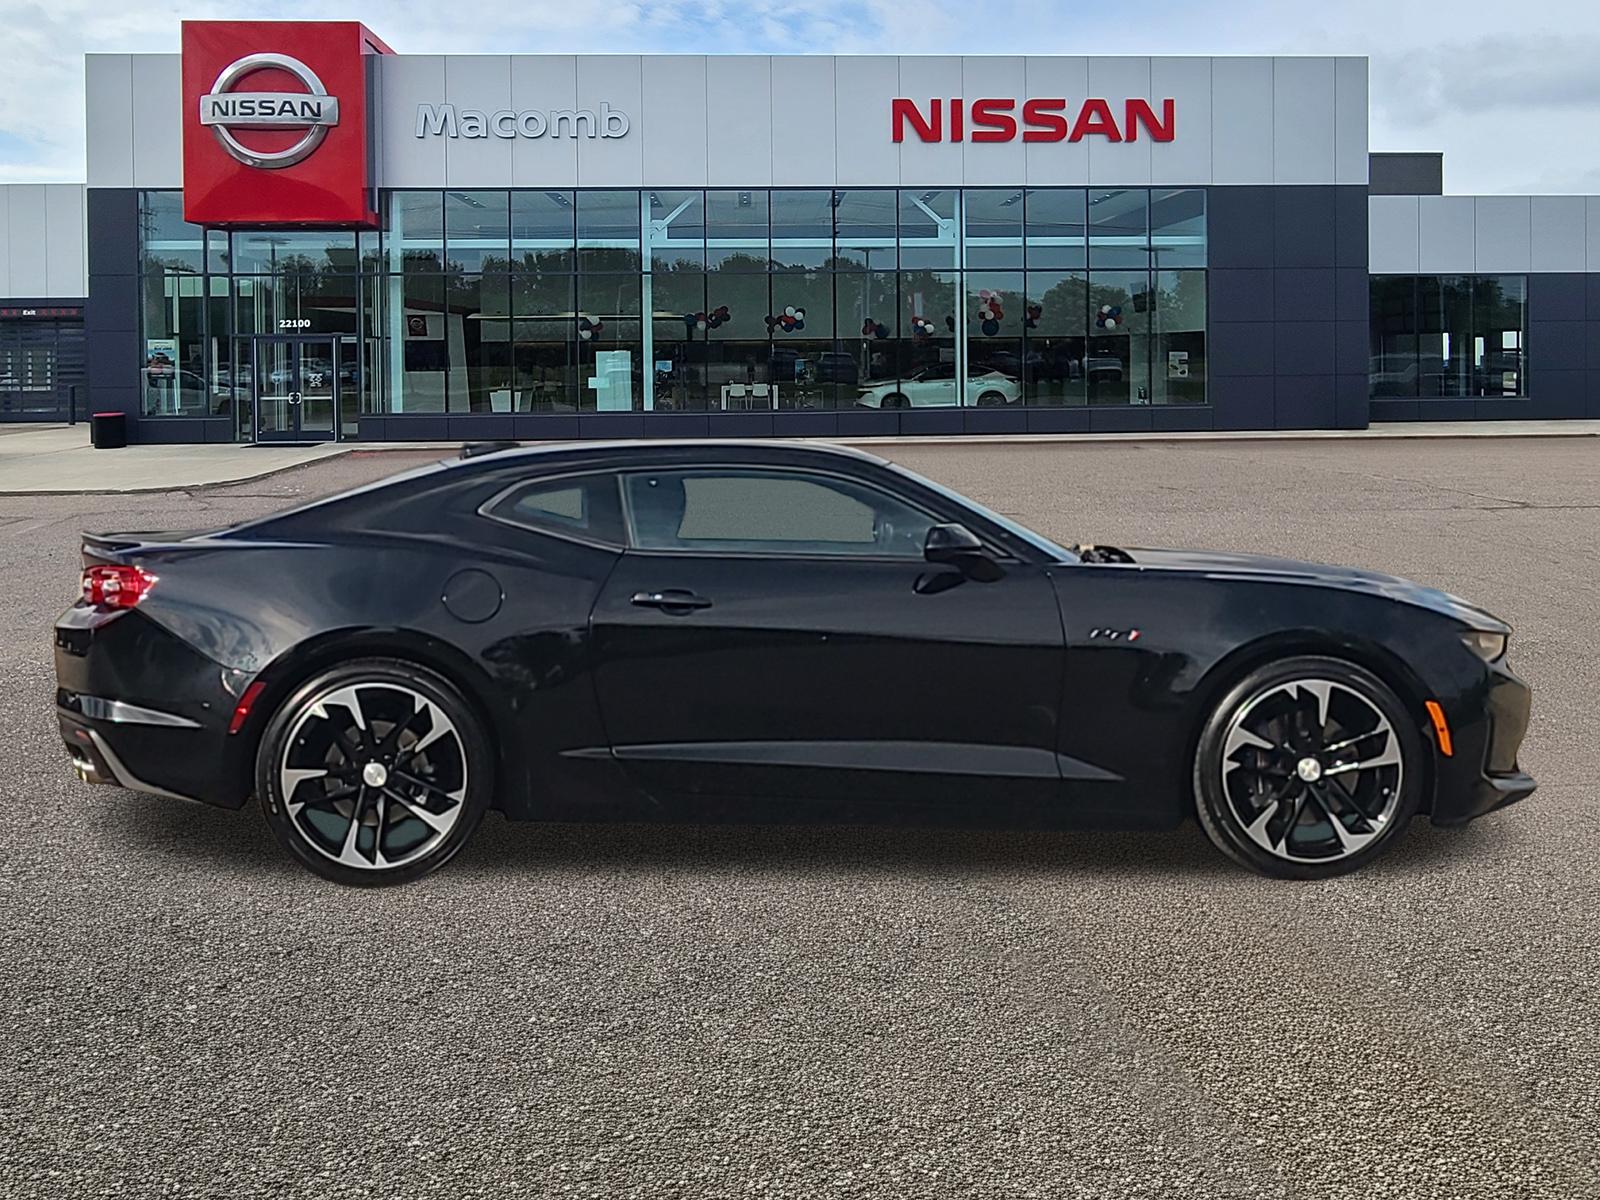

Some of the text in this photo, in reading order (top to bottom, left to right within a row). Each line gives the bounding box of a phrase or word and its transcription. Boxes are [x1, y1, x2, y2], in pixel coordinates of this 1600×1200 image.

[212, 100, 321, 117] NISSAN
[415, 102, 630, 138] Macomb
[892, 99, 1175, 143] NISSAN
[279, 319, 311, 328] 22100
